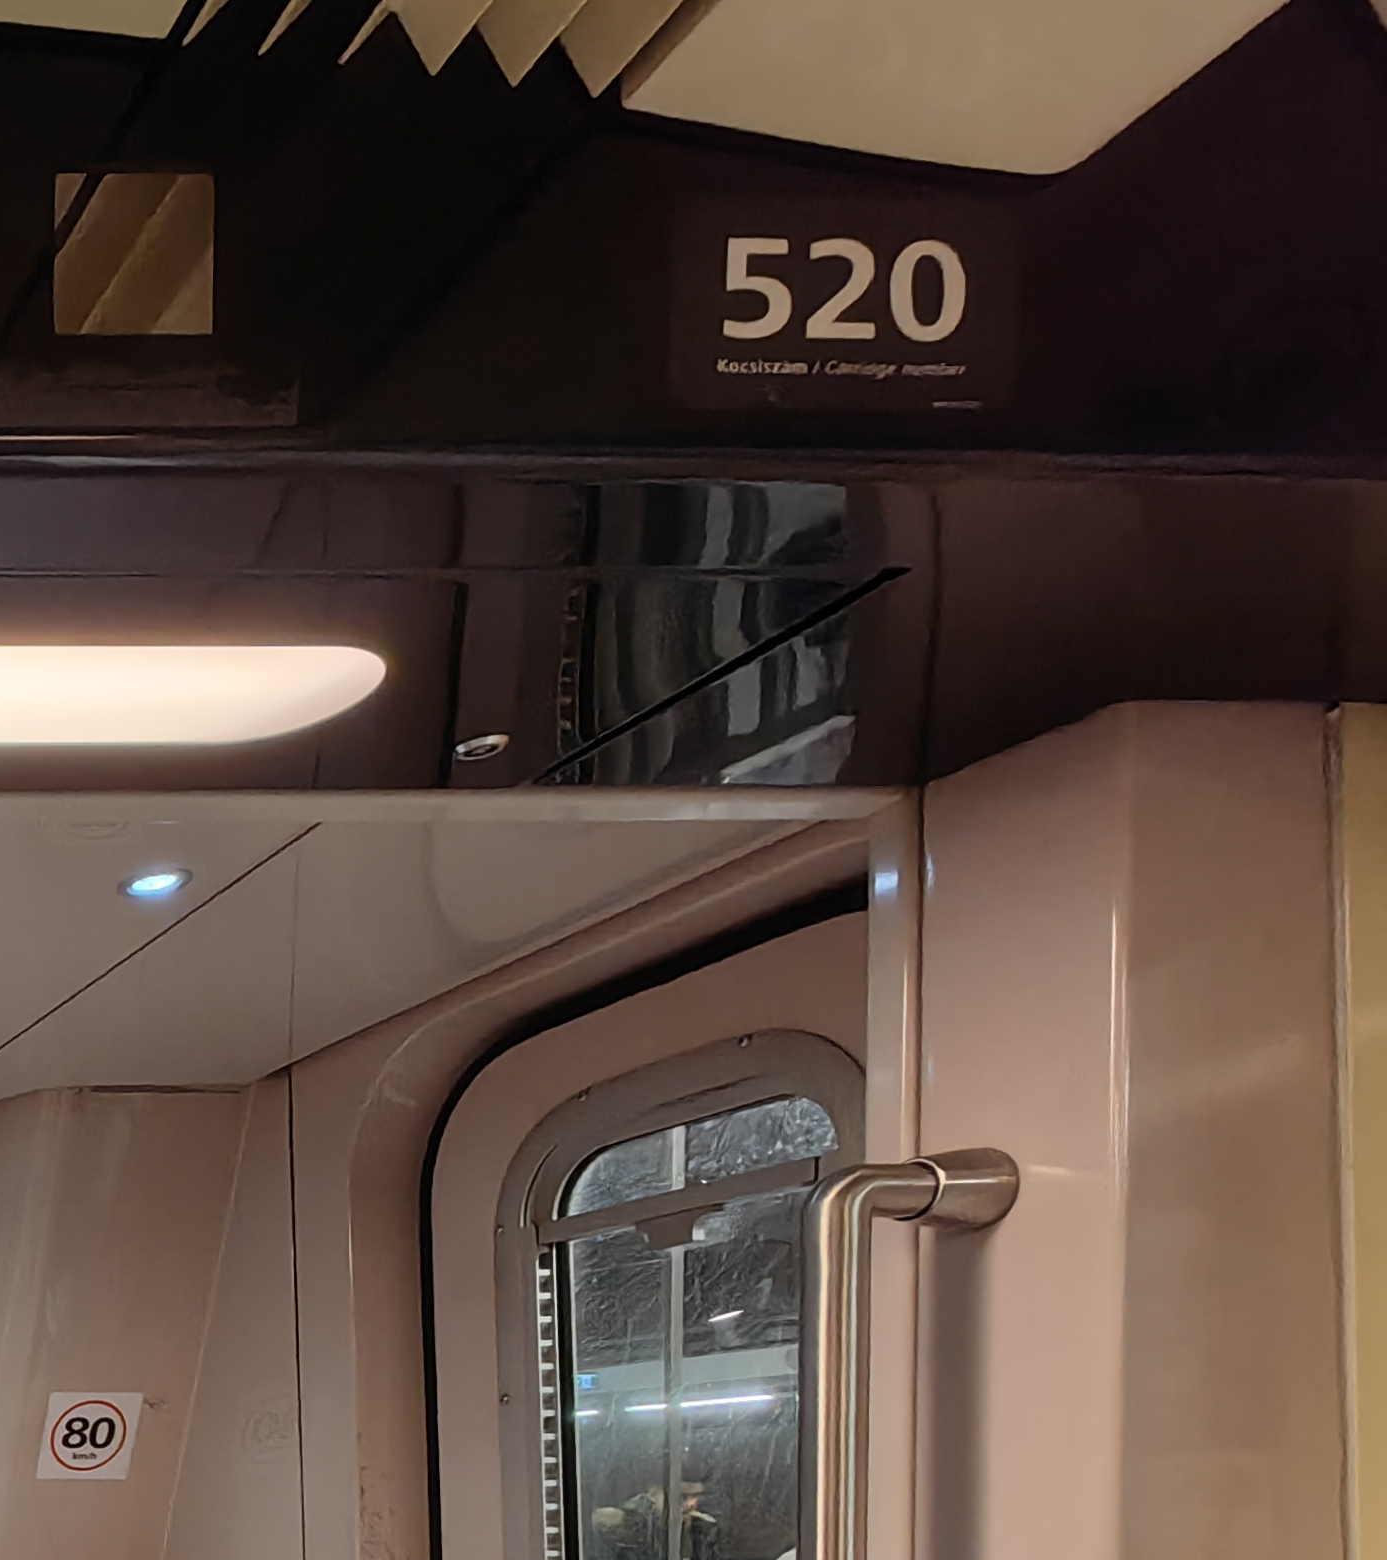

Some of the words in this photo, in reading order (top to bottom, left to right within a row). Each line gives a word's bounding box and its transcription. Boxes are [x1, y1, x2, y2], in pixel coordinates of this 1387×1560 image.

[721, 237, 967, 342] 520
[61, 1416, 117, 1449] 80
[72, 1452, 98, 1460] km/h
